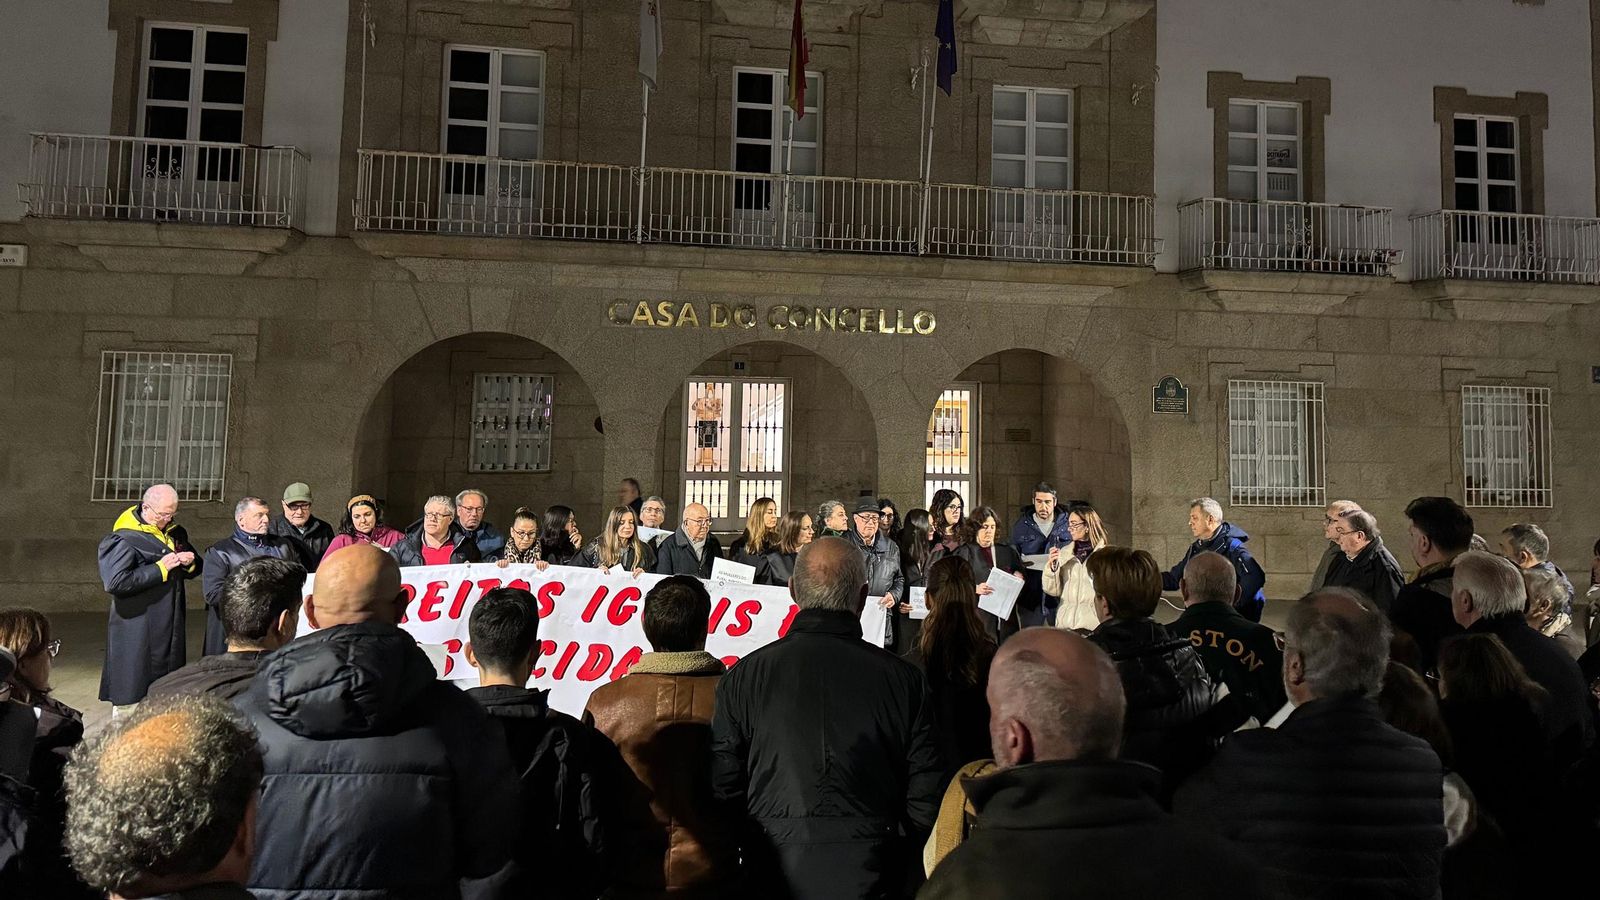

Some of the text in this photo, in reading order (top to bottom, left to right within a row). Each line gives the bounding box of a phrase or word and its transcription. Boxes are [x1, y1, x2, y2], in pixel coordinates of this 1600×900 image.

[608, 301, 937, 335] CASA DO CONCELLO
